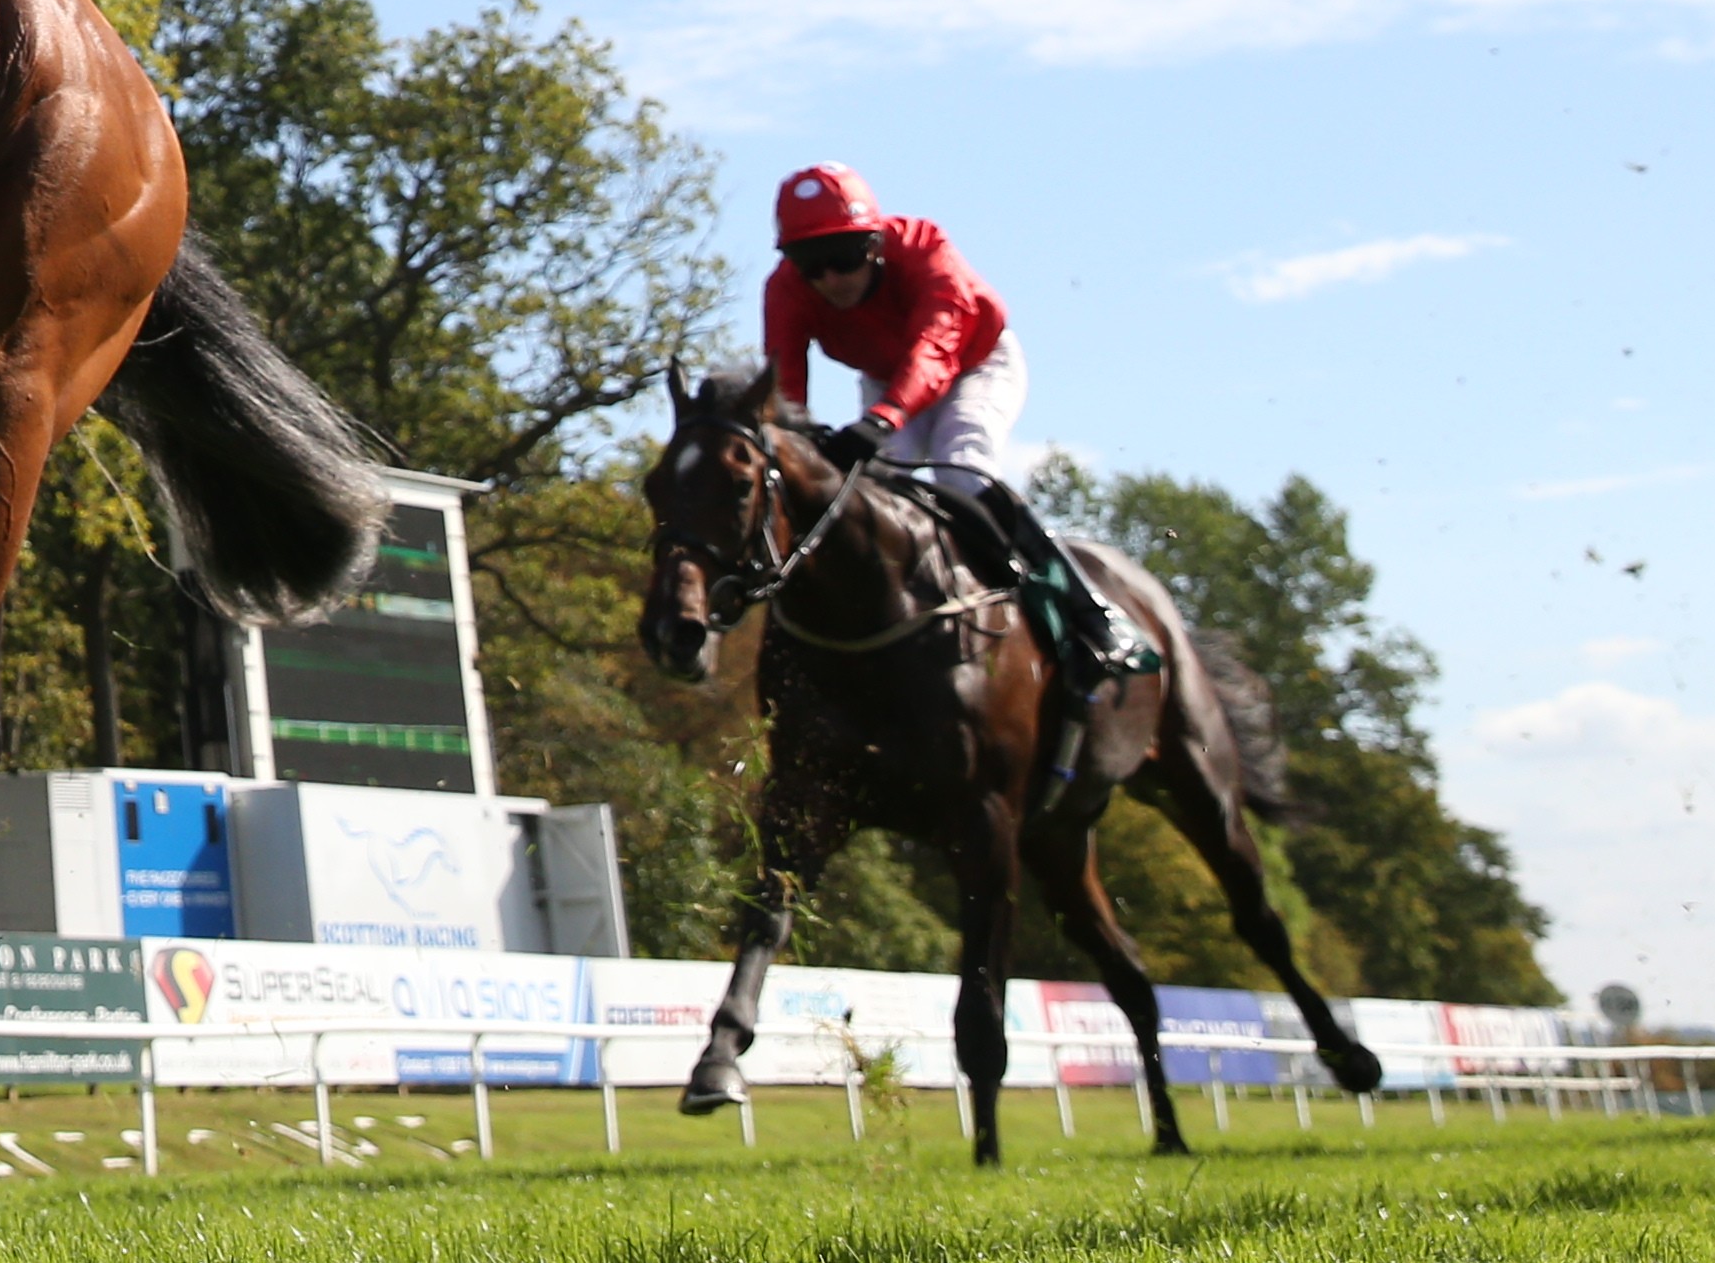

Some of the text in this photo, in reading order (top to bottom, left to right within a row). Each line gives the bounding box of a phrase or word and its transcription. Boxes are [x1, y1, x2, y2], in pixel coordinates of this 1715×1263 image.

[318, 921, 478, 948] SCOTTISH RACING
[53, 945, 123, 973] PARK
